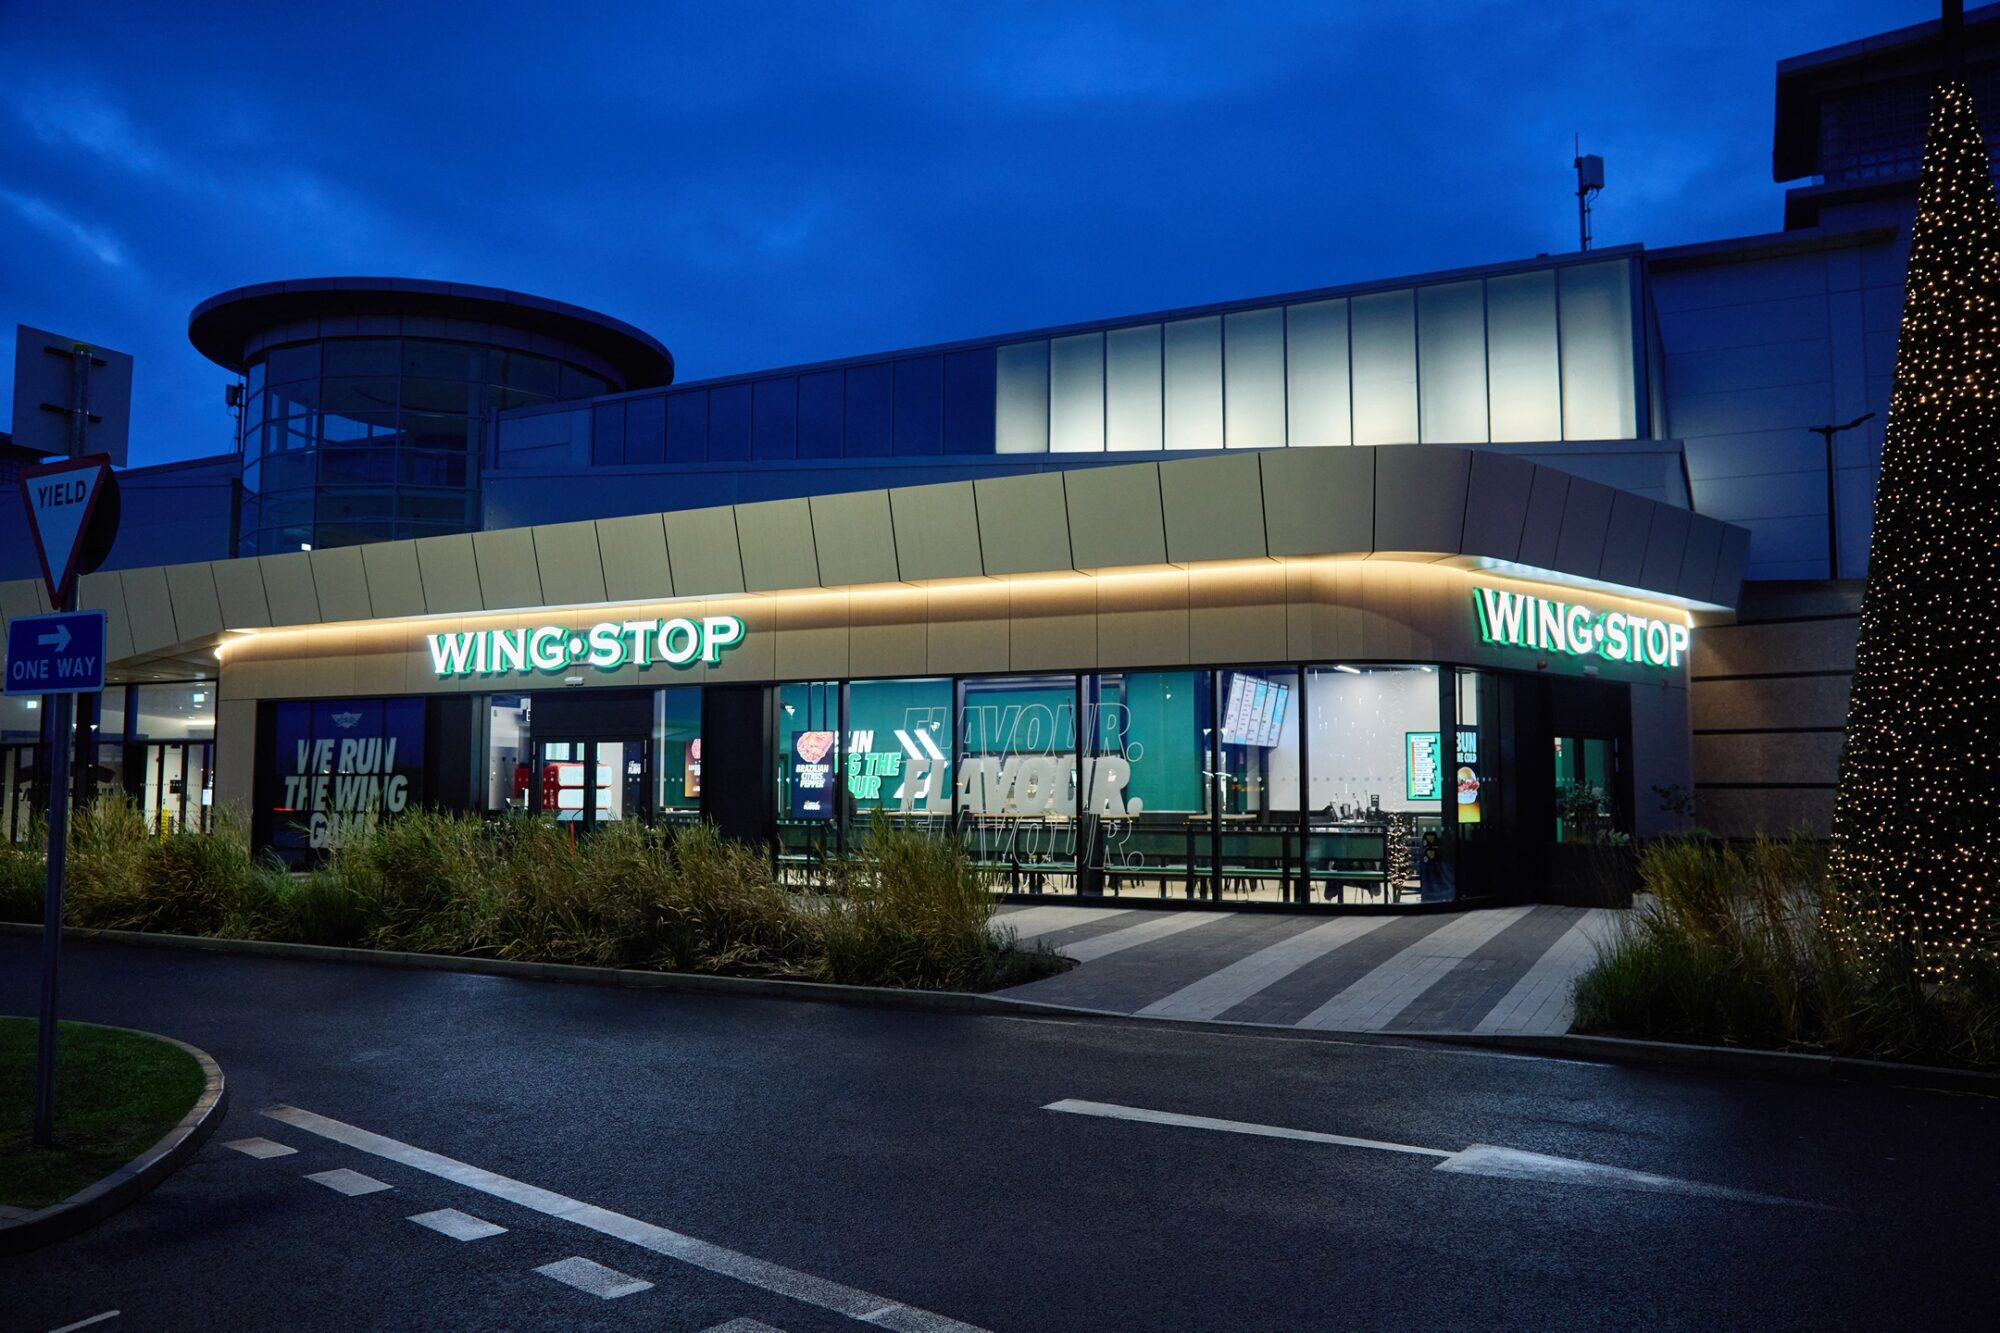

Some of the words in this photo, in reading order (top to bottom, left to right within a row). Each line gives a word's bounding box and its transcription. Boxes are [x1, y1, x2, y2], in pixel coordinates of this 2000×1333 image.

[38, 480, 87, 508] YIELD
[13, 659, 49, 681] ONE
[57, 656, 96, 678] WAY
[297, 739, 335, 774] WE
[338, 737, 397, 774] RUN
[865, 752, 902, 776] THE
[285, 775, 330, 811] THE
[335, 774, 408, 813] WING
